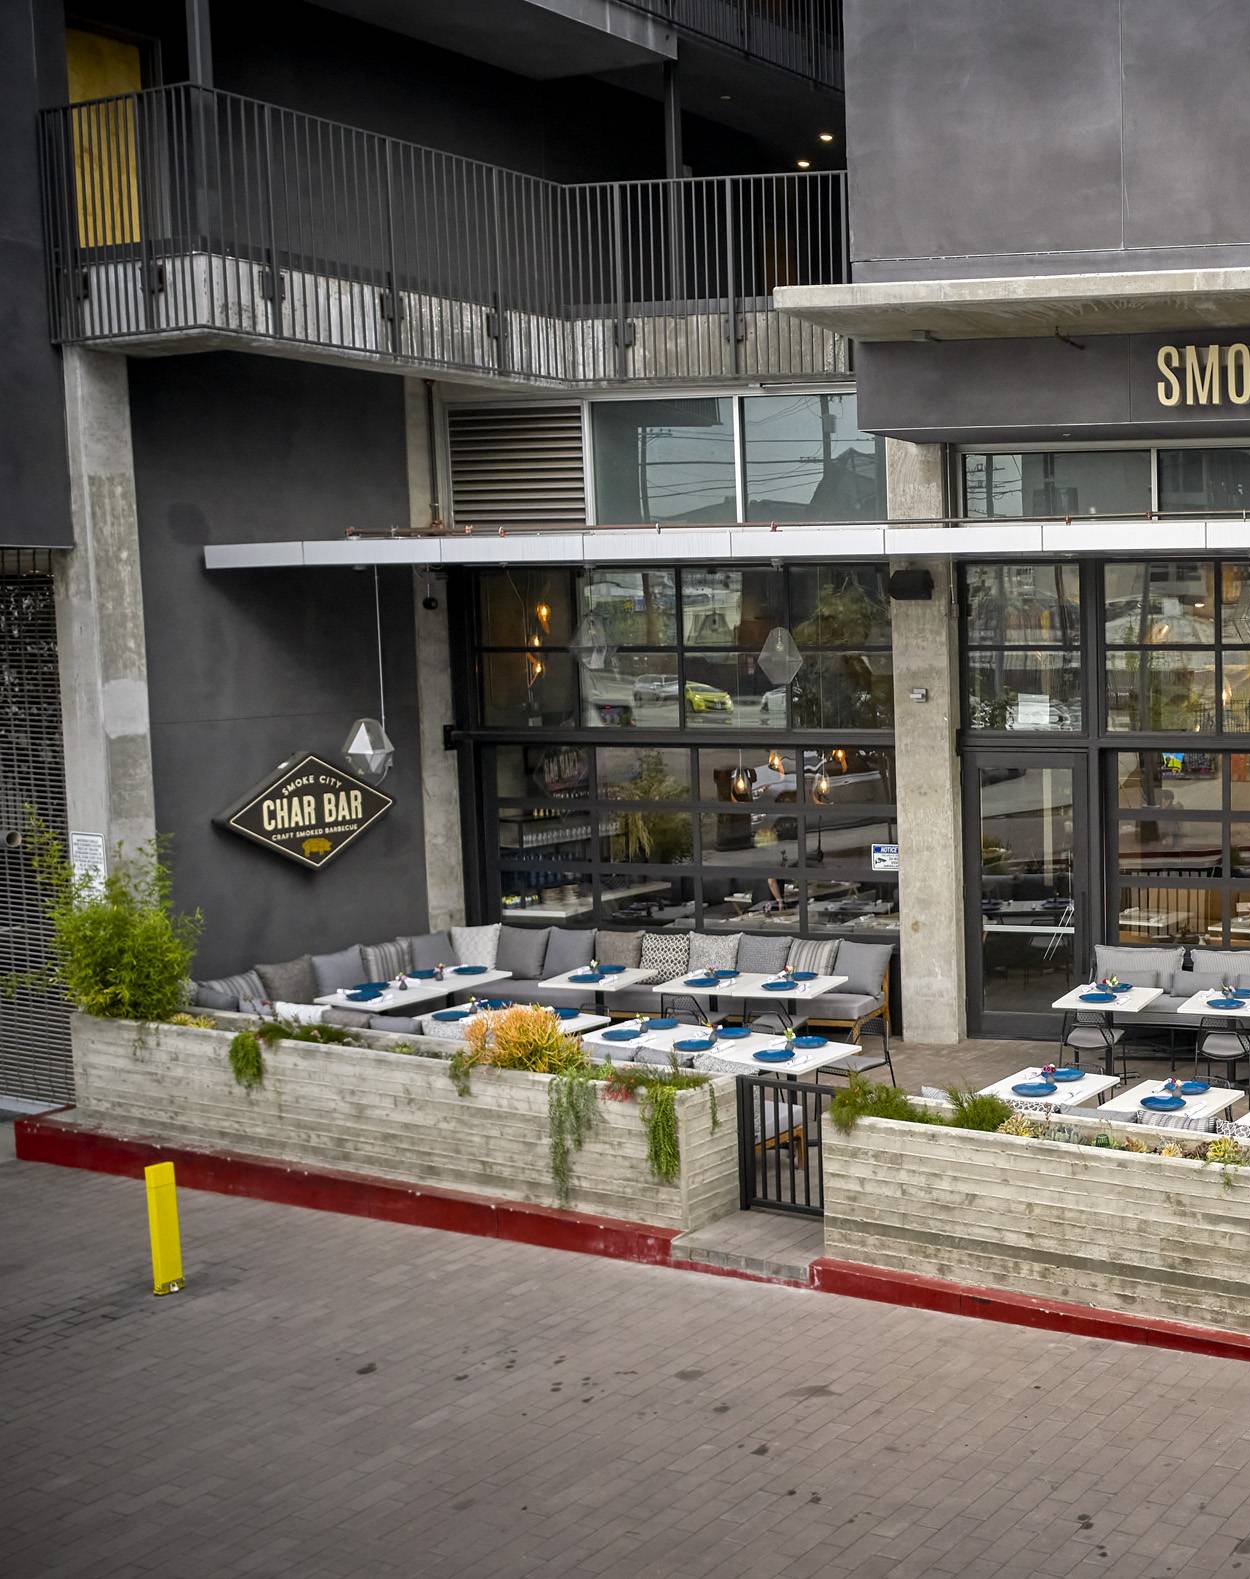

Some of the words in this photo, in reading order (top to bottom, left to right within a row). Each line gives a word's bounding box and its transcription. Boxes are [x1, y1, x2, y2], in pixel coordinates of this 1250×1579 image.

[281, 775, 315, 796] SMOKE
[319, 775, 343, 788] CITY
[262, 795, 316, 831] CHAR
[323, 790, 363, 823] BAR
[272, 832, 294, 841] CRAFT
[296, 829, 323, 838] SMOKED
[325, 824, 358, 834] BARBECUE
